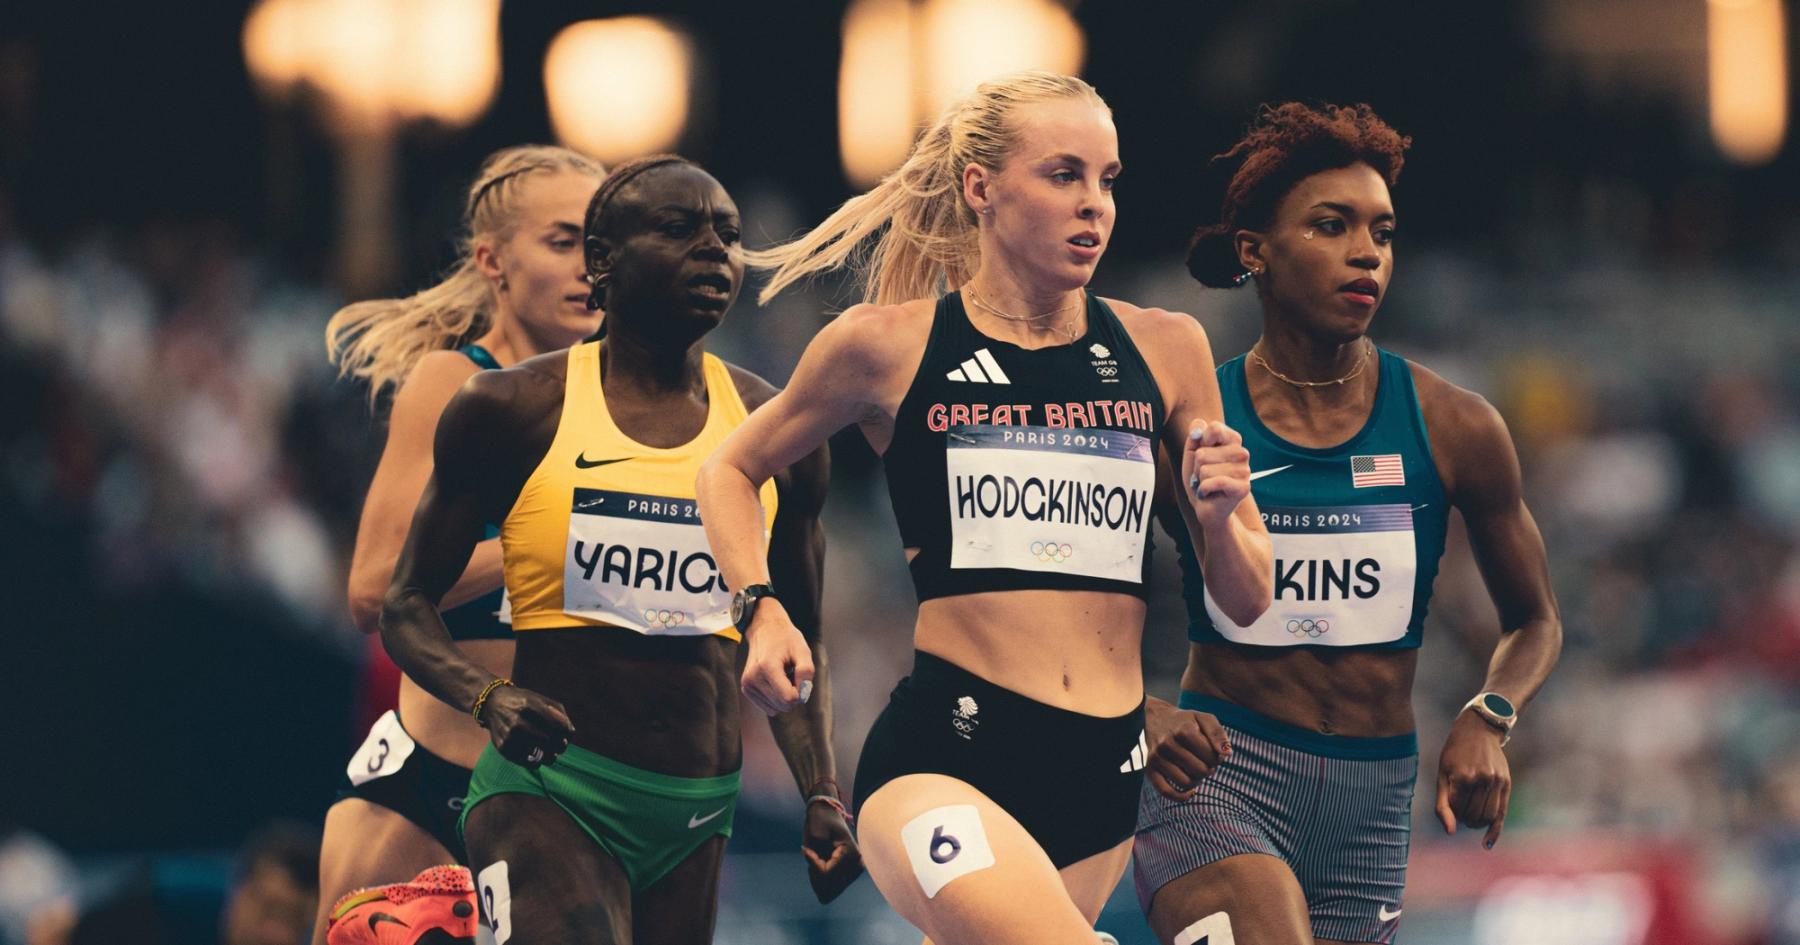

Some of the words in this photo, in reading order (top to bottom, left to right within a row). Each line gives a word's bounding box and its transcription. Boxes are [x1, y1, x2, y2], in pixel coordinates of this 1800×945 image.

[927, 403, 1032, 432] GREAT
[1045, 400, 1154, 431] BRITAIN
[1003, 431, 1056, 446] PARIS
[1063, 433, 1109, 450] 2024
[628, 499, 678, 516] PARIS
[956, 474, 1147, 533] HODGKINSON
[1261, 512, 1310, 527] PARIS
[1317, 513, 1361, 527] 2024
[1274, 558, 1381, 601] KINS
[367, 738, 390, 774] 3
[929, 825, 962, 864] 6
